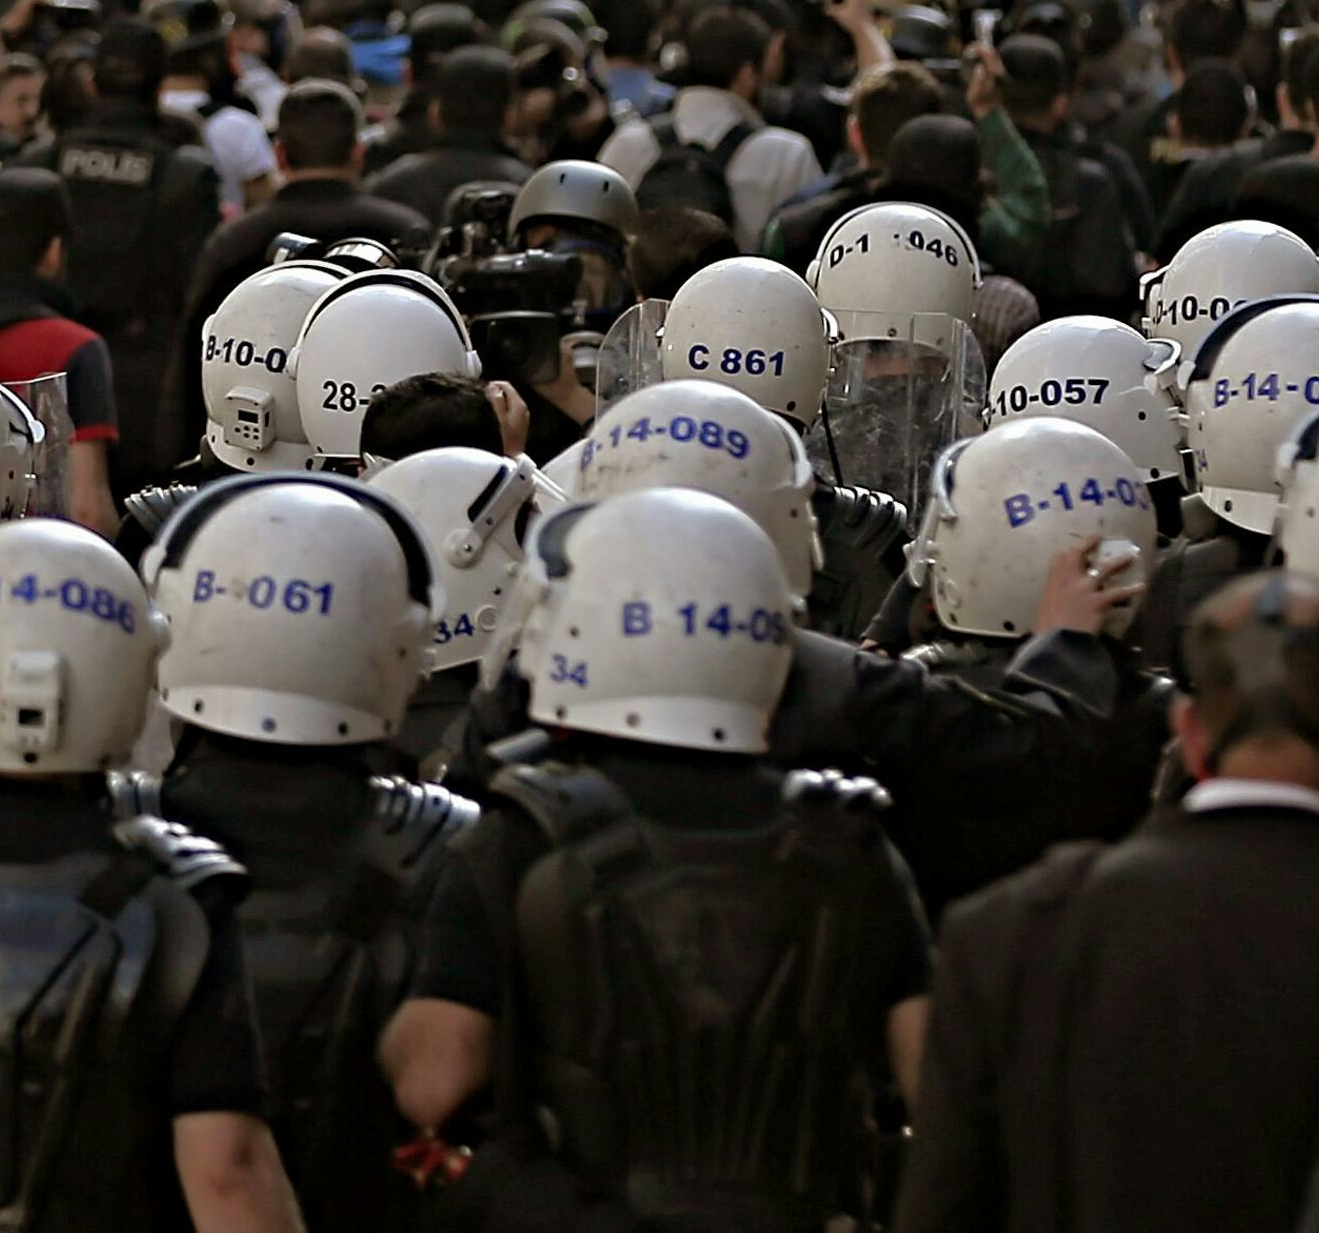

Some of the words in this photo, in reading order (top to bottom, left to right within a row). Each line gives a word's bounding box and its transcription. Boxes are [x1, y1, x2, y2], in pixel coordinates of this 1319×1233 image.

[1153, 297, 1248, 325] D-10-0
[689, 345, 709, 369] C
[721, 349, 784, 376] 861
[551, 653, 588, 688] 34
